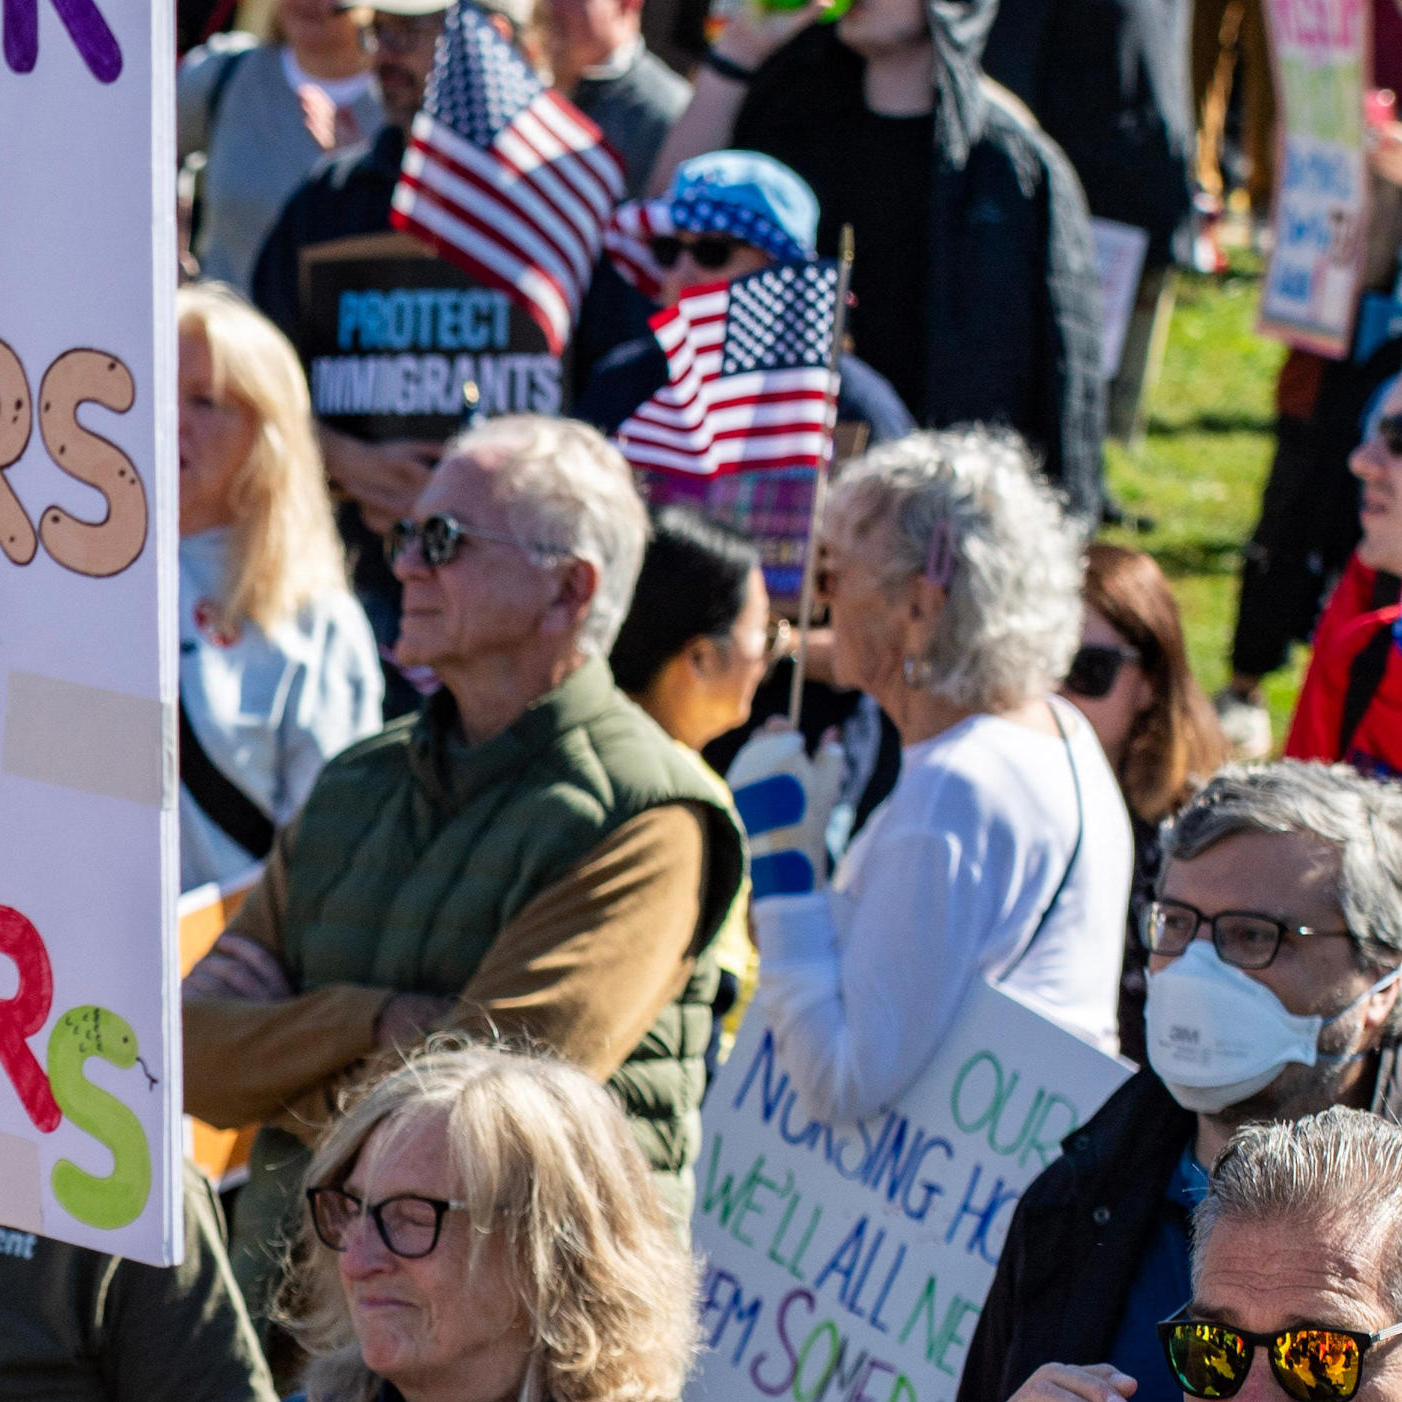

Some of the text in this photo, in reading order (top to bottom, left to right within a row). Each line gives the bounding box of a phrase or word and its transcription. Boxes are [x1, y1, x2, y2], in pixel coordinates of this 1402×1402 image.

[337, 288, 510, 349] PROTECT
[311, 353, 563, 415] IMMIGRANTS
[950, 1048, 1079, 1170] OUR
[701, 1133, 823, 1282] WE'LL
[814, 1214, 908, 1335] ALL
